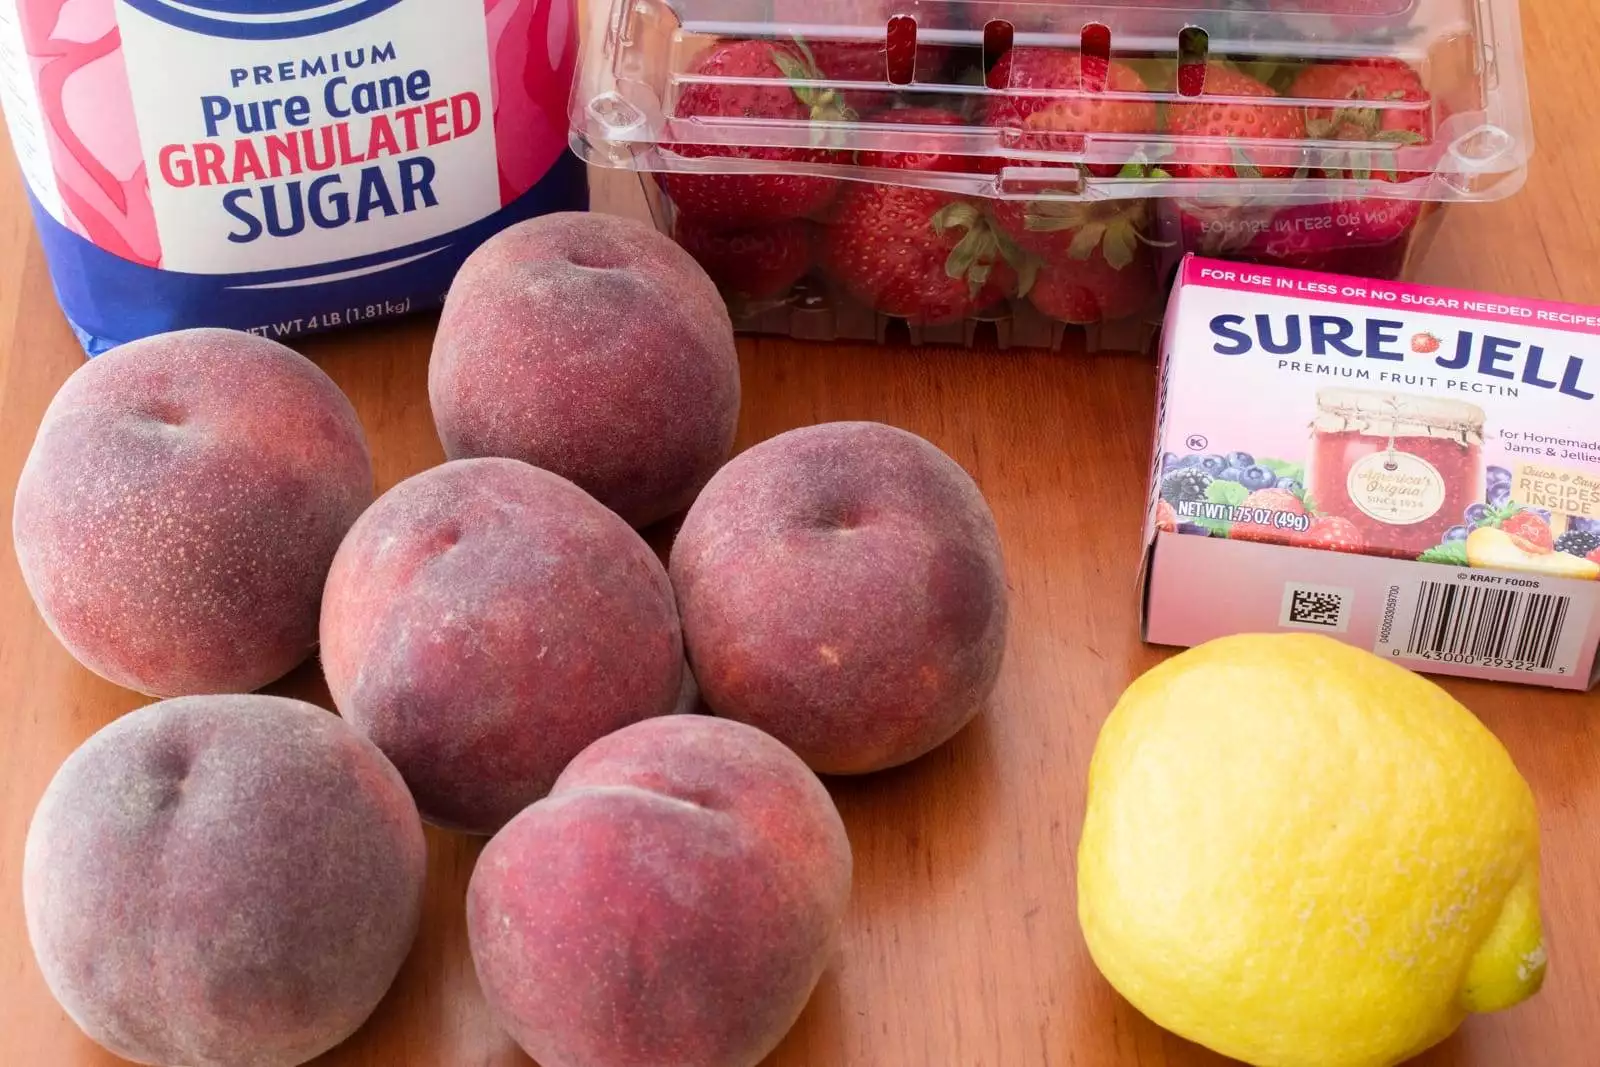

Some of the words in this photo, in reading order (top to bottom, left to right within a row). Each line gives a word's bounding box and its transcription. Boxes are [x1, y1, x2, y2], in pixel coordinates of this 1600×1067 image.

[230, 41, 396, 88] PREMIUM
[200, 95, 310, 137] Pure
[324, 69, 431, 117] Cane
[158, 91, 482, 188] GRANULATED
[222, 156, 439, 243] SUGAR
[1201, 268, 1236, 282] FOR
[1240, 273, 1271, 287] USE
[1276, 278, 1293, 289] IN
[1298, 281, 1337, 295] LESS
[1341, 287, 1367, 298] OR
[1371, 290, 1397, 302] NO
[1400, 293, 1459, 309] SUGAR
[1463, 301, 1532, 318] NEEDED
[246, 325, 269, 339] ET
[272, 319, 303, 336] WT
[308, 316, 318, 329] 4
[323, 312, 341, 327] LB
[1209, 314, 1404, 361] SURE
[1436, 330, 1594, 400] JELL
[1278, 359, 1370, 379] PREMIUM
[1380, 372, 1438, 387] FRUIT
[1447, 380, 1519, 397] PECTIN
[1500, 429, 1520, 439] for
[1504, 442, 1541, 454] Jams
[1545, 448, 1556, 456] &
[1520, 478, 1600, 503] RECIPES
[1526, 492, 1592, 514] INSIDE
[1178, 501, 1203, 516] NET
[1205, 504, 1226, 519] WT
[1228, 506, 1252, 521] 1.75
[1254, 508, 1271, 525] OZ
[1274, 511, 1309, 531] (49g)
[1470, 574, 1503, 584] KRAFT
[1505, 577, 1540, 588] FOODS
[1392, 648, 1400, 656] 0
[1422, 651, 1475, 664] 43000
[1483, 657, 1535, 671] 29322
[1558, 666, 1566, 674] 5
